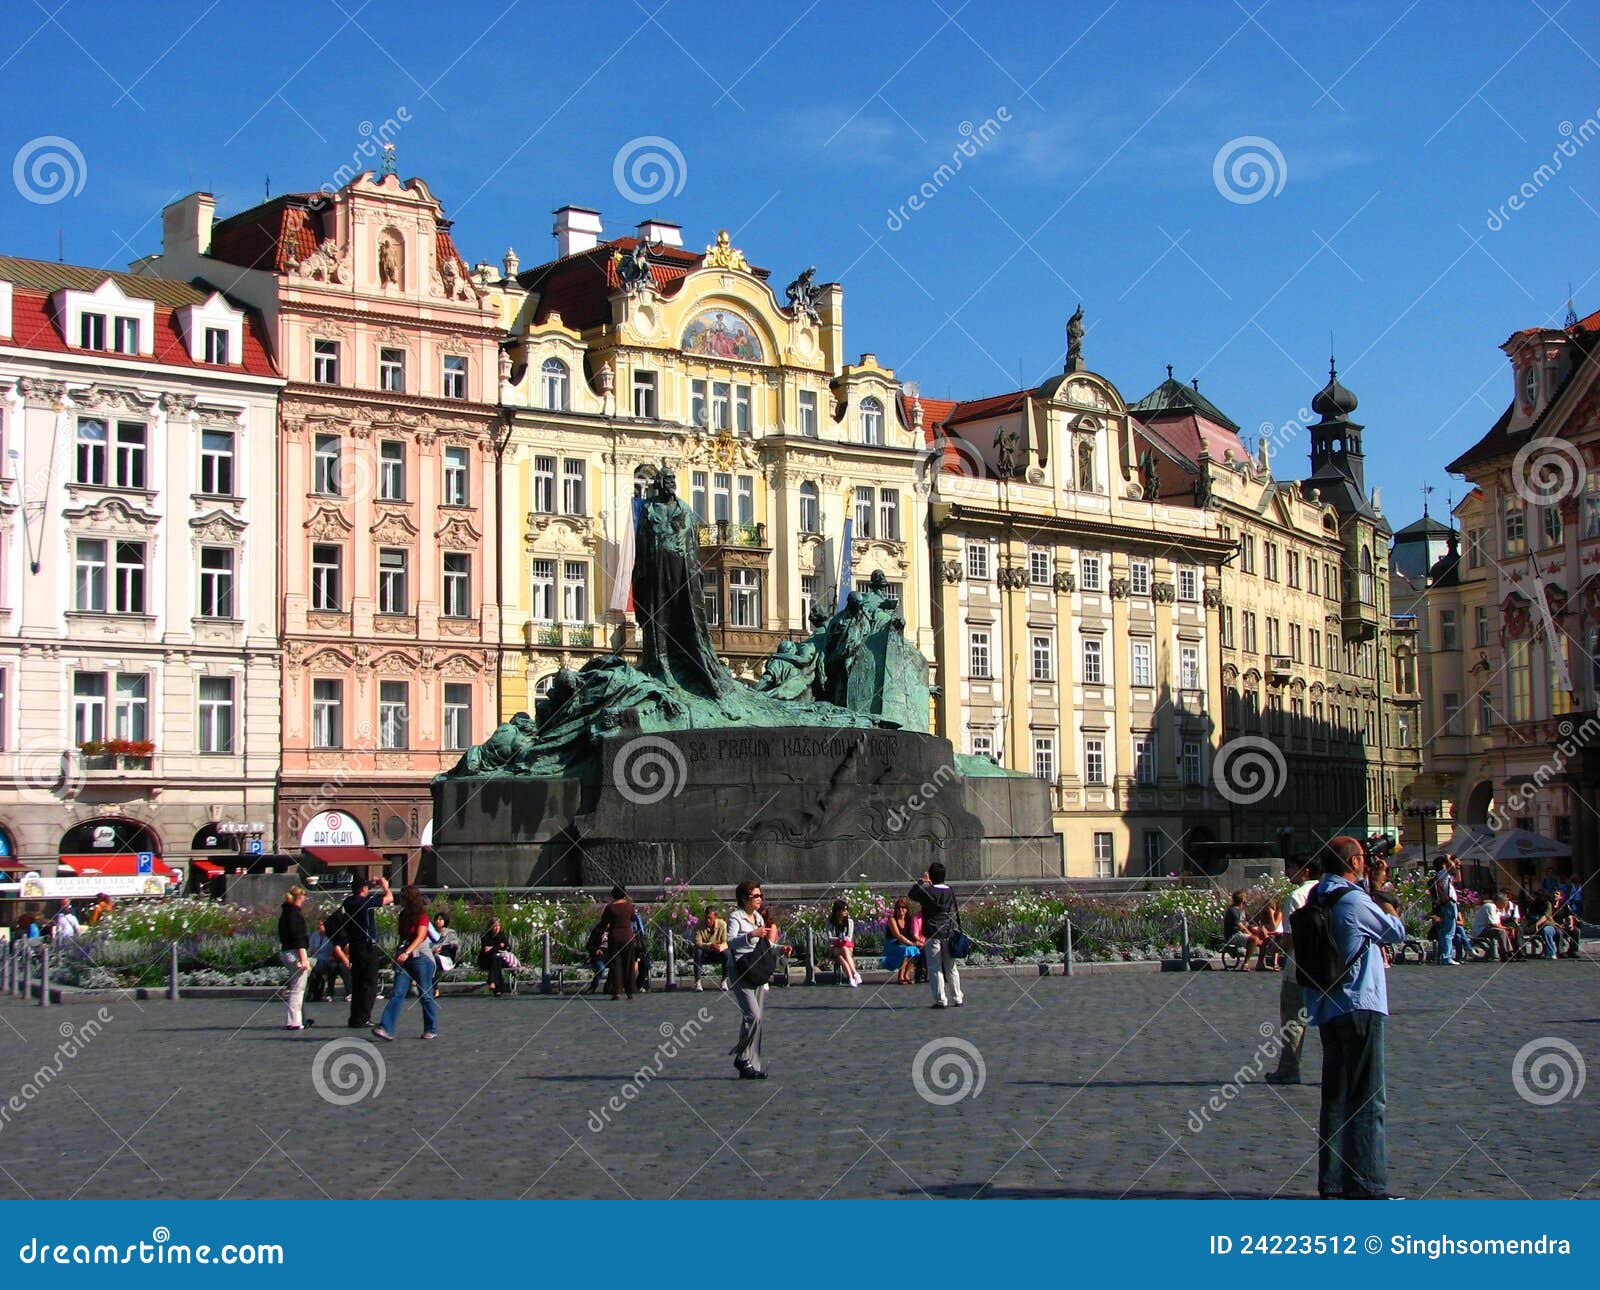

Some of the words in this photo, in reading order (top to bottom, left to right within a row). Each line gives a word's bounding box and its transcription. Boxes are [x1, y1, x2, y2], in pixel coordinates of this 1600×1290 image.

[314, 831, 329, 845] ART
[331, 831, 353, 845] GLASS
[141, 855, 149, 868] P
